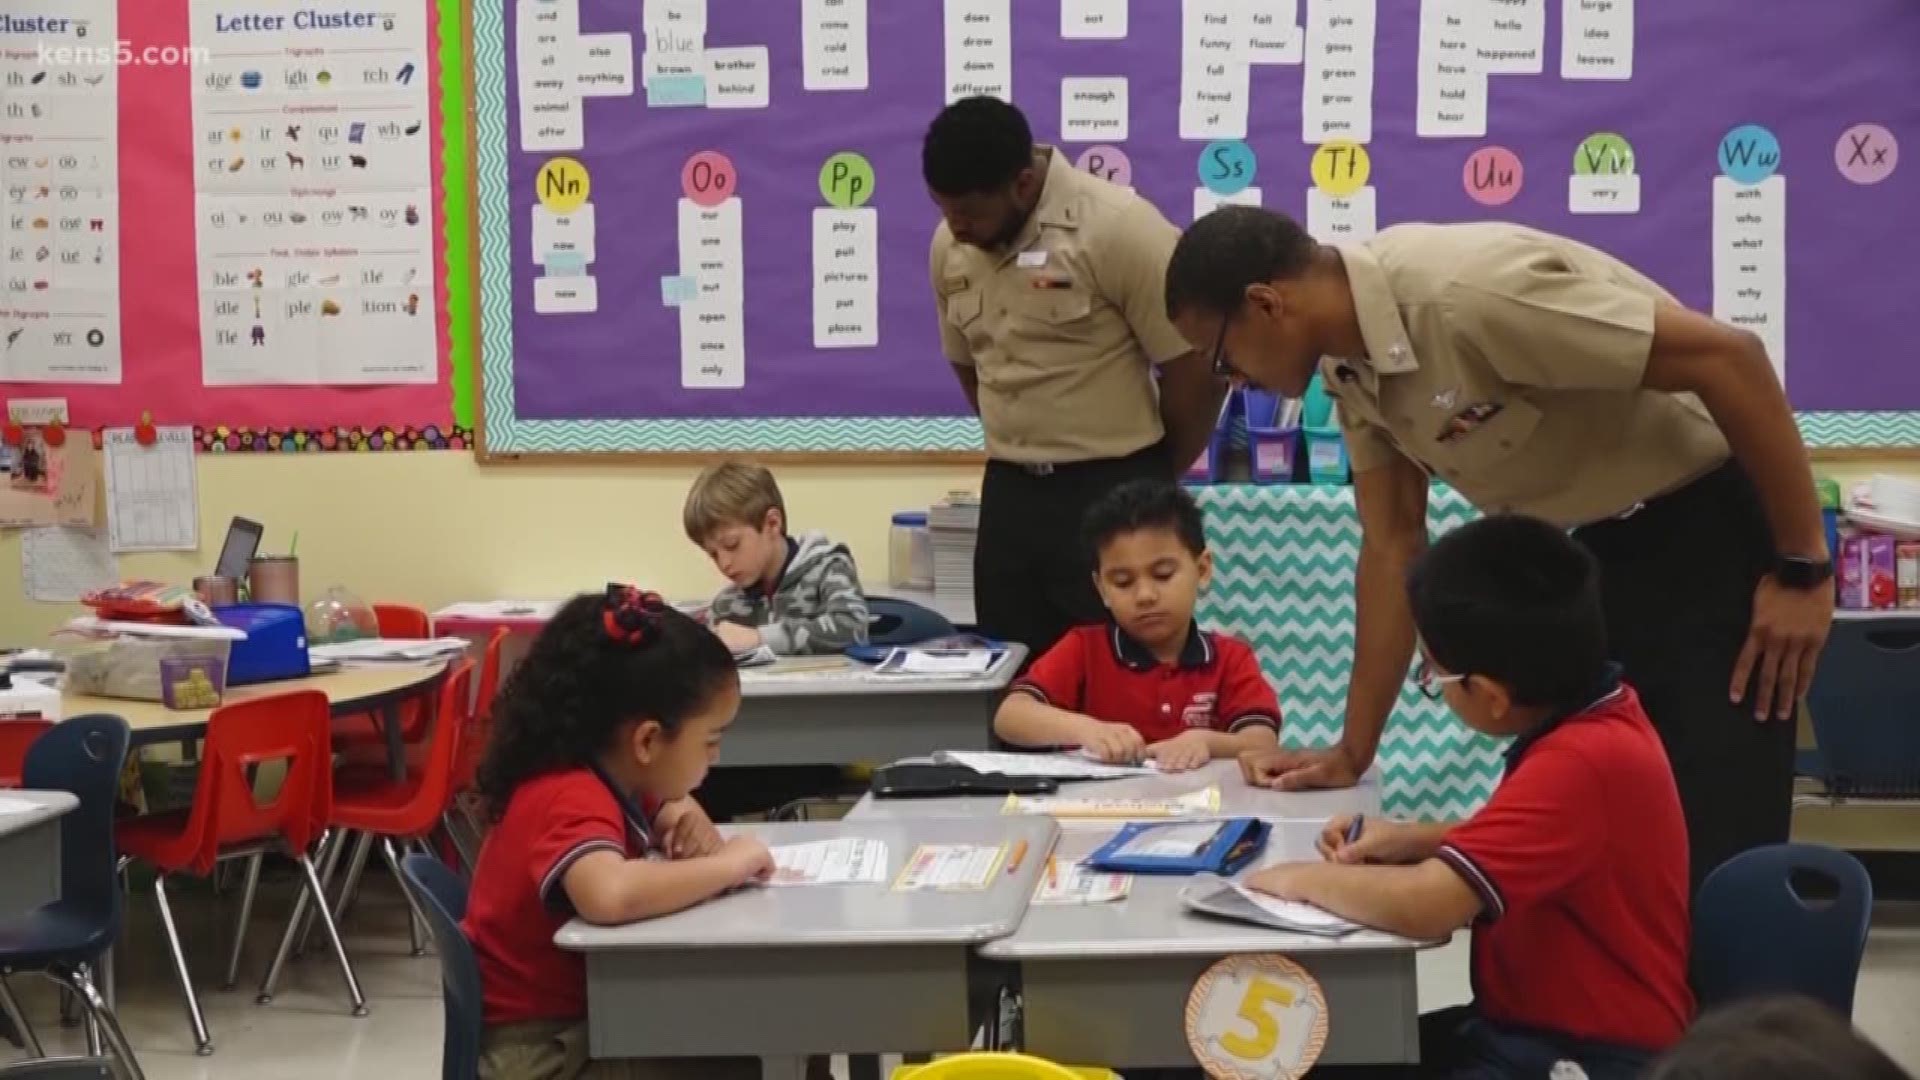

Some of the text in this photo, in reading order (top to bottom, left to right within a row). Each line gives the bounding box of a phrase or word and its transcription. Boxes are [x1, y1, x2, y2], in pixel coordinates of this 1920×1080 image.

[1580, 0, 1613, 13] large
[215, 10, 377, 34] Letter Cluster
[536, 10, 558, 22] and
[667, 10, 682, 22] be
[963, 12, 991, 24] does
[1203, 13, 1228, 25] find
[1252, 13, 1273, 25] fall
[1328, 15, 1354, 29] give
[1446, 14, 1462, 26] he
[0, 14, 70, 33] luster
[1493, 18, 1523, 31] hello
[655, 27, 694, 53] blue
[1583, 28, 1611, 40] idea
[1199, 36, 1232, 52] funny
[1248, 38, 1287, 49] flower
[1324, 42, 1353, 55] goes
[1439, 38, 1467, 50] here
[1476, 47, 1536, 61] happened
[1576, 53, 1616, 66] leaves
[656, 64, 693, 76] brown
[713, 59, 756, 71] brother
[821, 64, 850, 76] cried
[962, 60, 995, 72] down
[1205, 64, 1225, 77] full
[1437, 62, 1467, 74] have
[6, 71, 77, 87] th sh
[204, 72, 233, 92] dge
[284, 69, 308, 90] igh
[576, 72, 625, 85] anything
[1321, 68, 1357, 82] green
[717, 83, 756, 94] behind
[951, 82, 1004, 95] different
[1439, 88, 1466, 100] hold
[1073, 90, 1116, 104] enough
[1196, 90, 1232, 103] friend
[1321, 94, 1353, 106] grow
[6, 102, 24, 118] th
[532, 101, 570, 114] animal
[1206, 113, 1220, 126] of
[1437, 110, 1465, 122] hear
[377, 120, 402, 137] wh
[1067, 119, 1120, 130] everyone
[537, 126, 566, 138] after
[1724, 139, 1778, 167] Ww
[1848, 133, 1888, 168] Xx
[58, 155, 78, 169] oo
[1089, 155, 1119, 181] Rr
[1212, 146, 1243, 180] Ss
[1323, 146, 1356, 180] Tt
[692, 161, 726, 192] Oo
[1473, 157, 1513, 190] Uu
[546, 167, 580, 198] Nn
[832, 162, 862, 205] Pp
[1591, 189, 1619, 200] very
[1734, 188, 1762, 199] with
[1331, 198, 1351, 210] the
[1735, 212, 1762, 224] who
[831, 220, 857, 234] play
[1331, 223, 1353, 233] too
[1731, 238, 1764, 250] what
[834, 246, 856, 259] pull
[1739, 264, 1758, 274] we
[823, 272, 869, 284] pictures
[1736, 287, 1762, 301] why
[362, 300, 397, 313] tion
[835, 299, 855, 310] put
[698, 313, 727, 324] open
[1730, 312, 1768, 325] would
[827, 323, 862, 336] places
[700, 364, 724, 378] only
[1220, 977, 1296, 1061] 5
